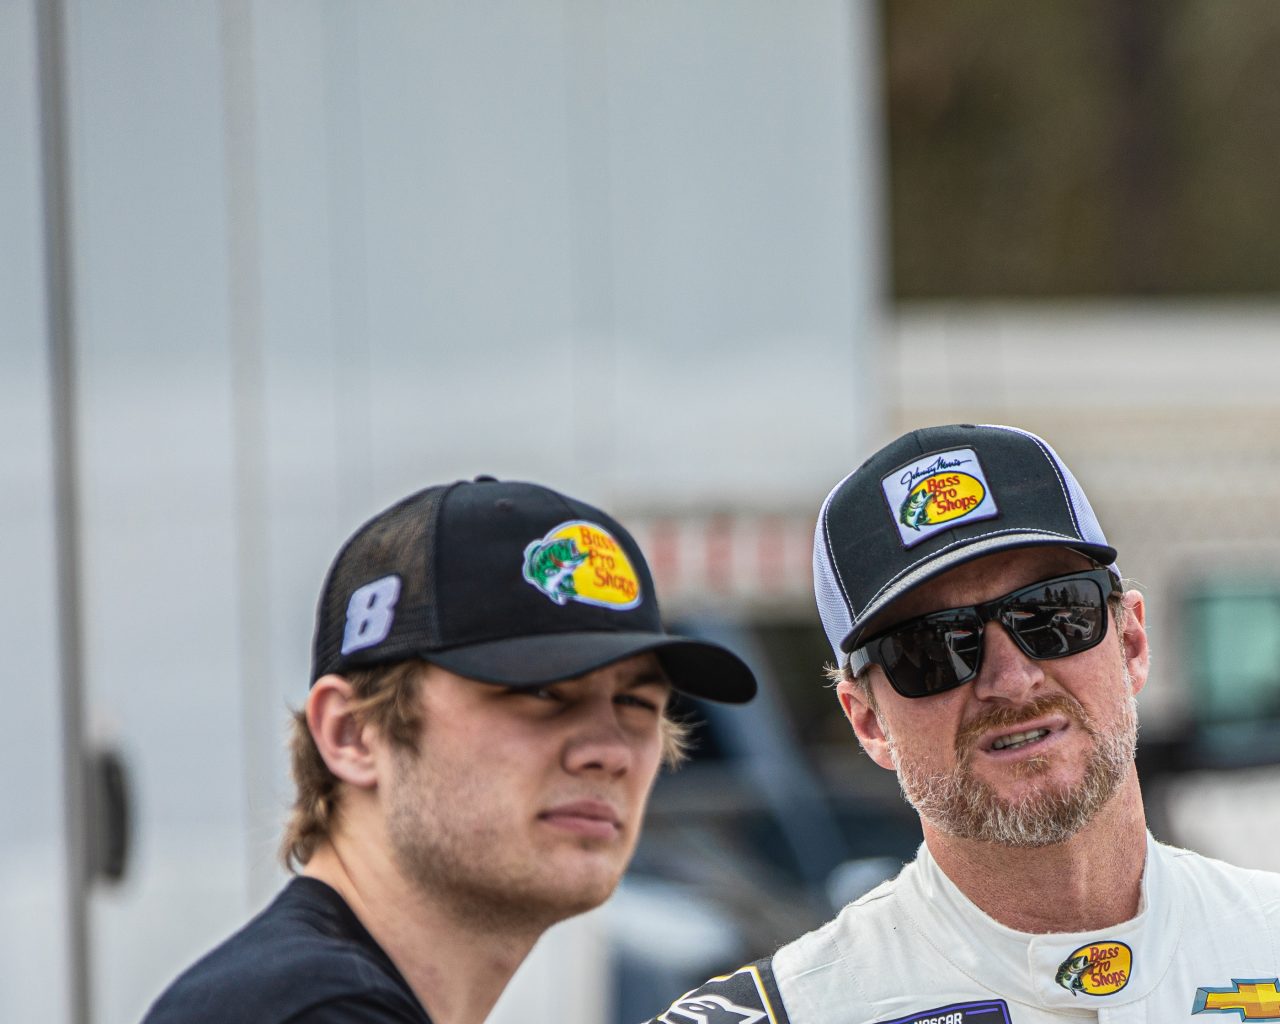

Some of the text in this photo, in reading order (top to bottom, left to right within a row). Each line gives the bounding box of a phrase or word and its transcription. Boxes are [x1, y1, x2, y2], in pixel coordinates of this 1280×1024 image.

[926, 475, 960, 493] Bass
[932, 488, 957, 503] Pro
[936, 495, 978, 515] Shops
[579, 525, 616, 552] Bass
[589, 547, 615, 570] Pro
[593, 567, 636, 599] Shops
[341, 574, 401, 656] 8
[1089, 946, 1120, 962] Bass
[1088, 960, 1111, 974] Pro
[1091, 970, 1126, 987] Shops
